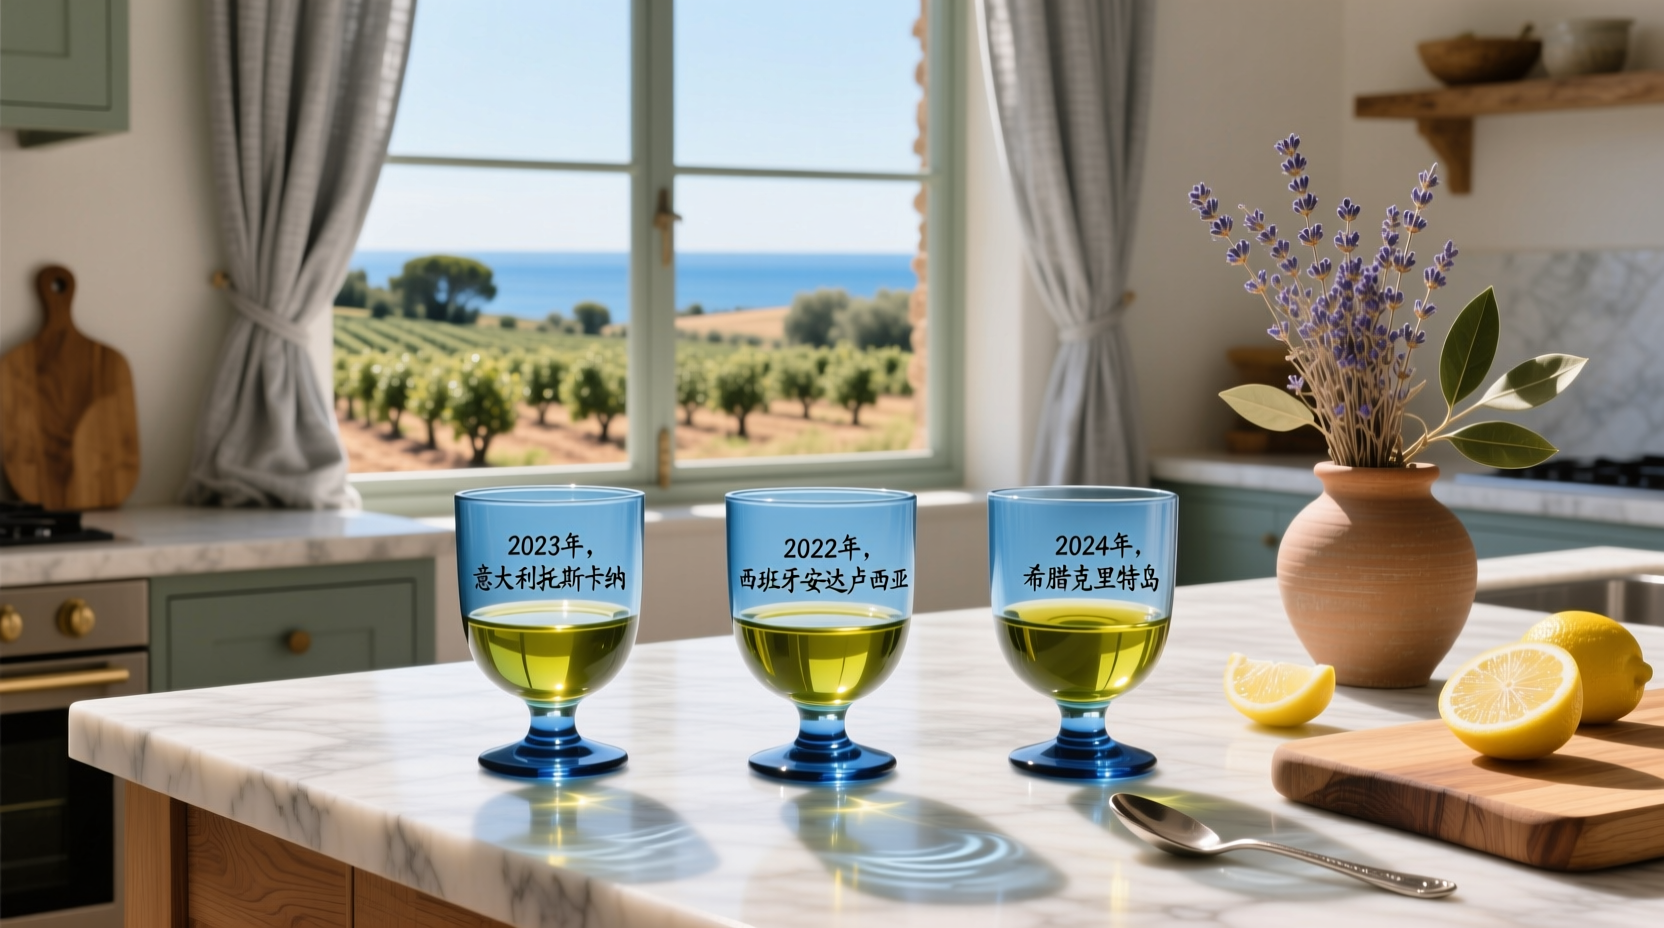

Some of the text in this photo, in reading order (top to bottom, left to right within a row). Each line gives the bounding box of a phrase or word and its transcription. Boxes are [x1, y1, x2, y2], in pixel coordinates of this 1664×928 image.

[472, 563, 626, 592] 意大利托斯卡纳
[739, 566, 909, 595] 西班牙安达卢西亚
[1023, 563, 1160, 592] 希腊克里特岛
